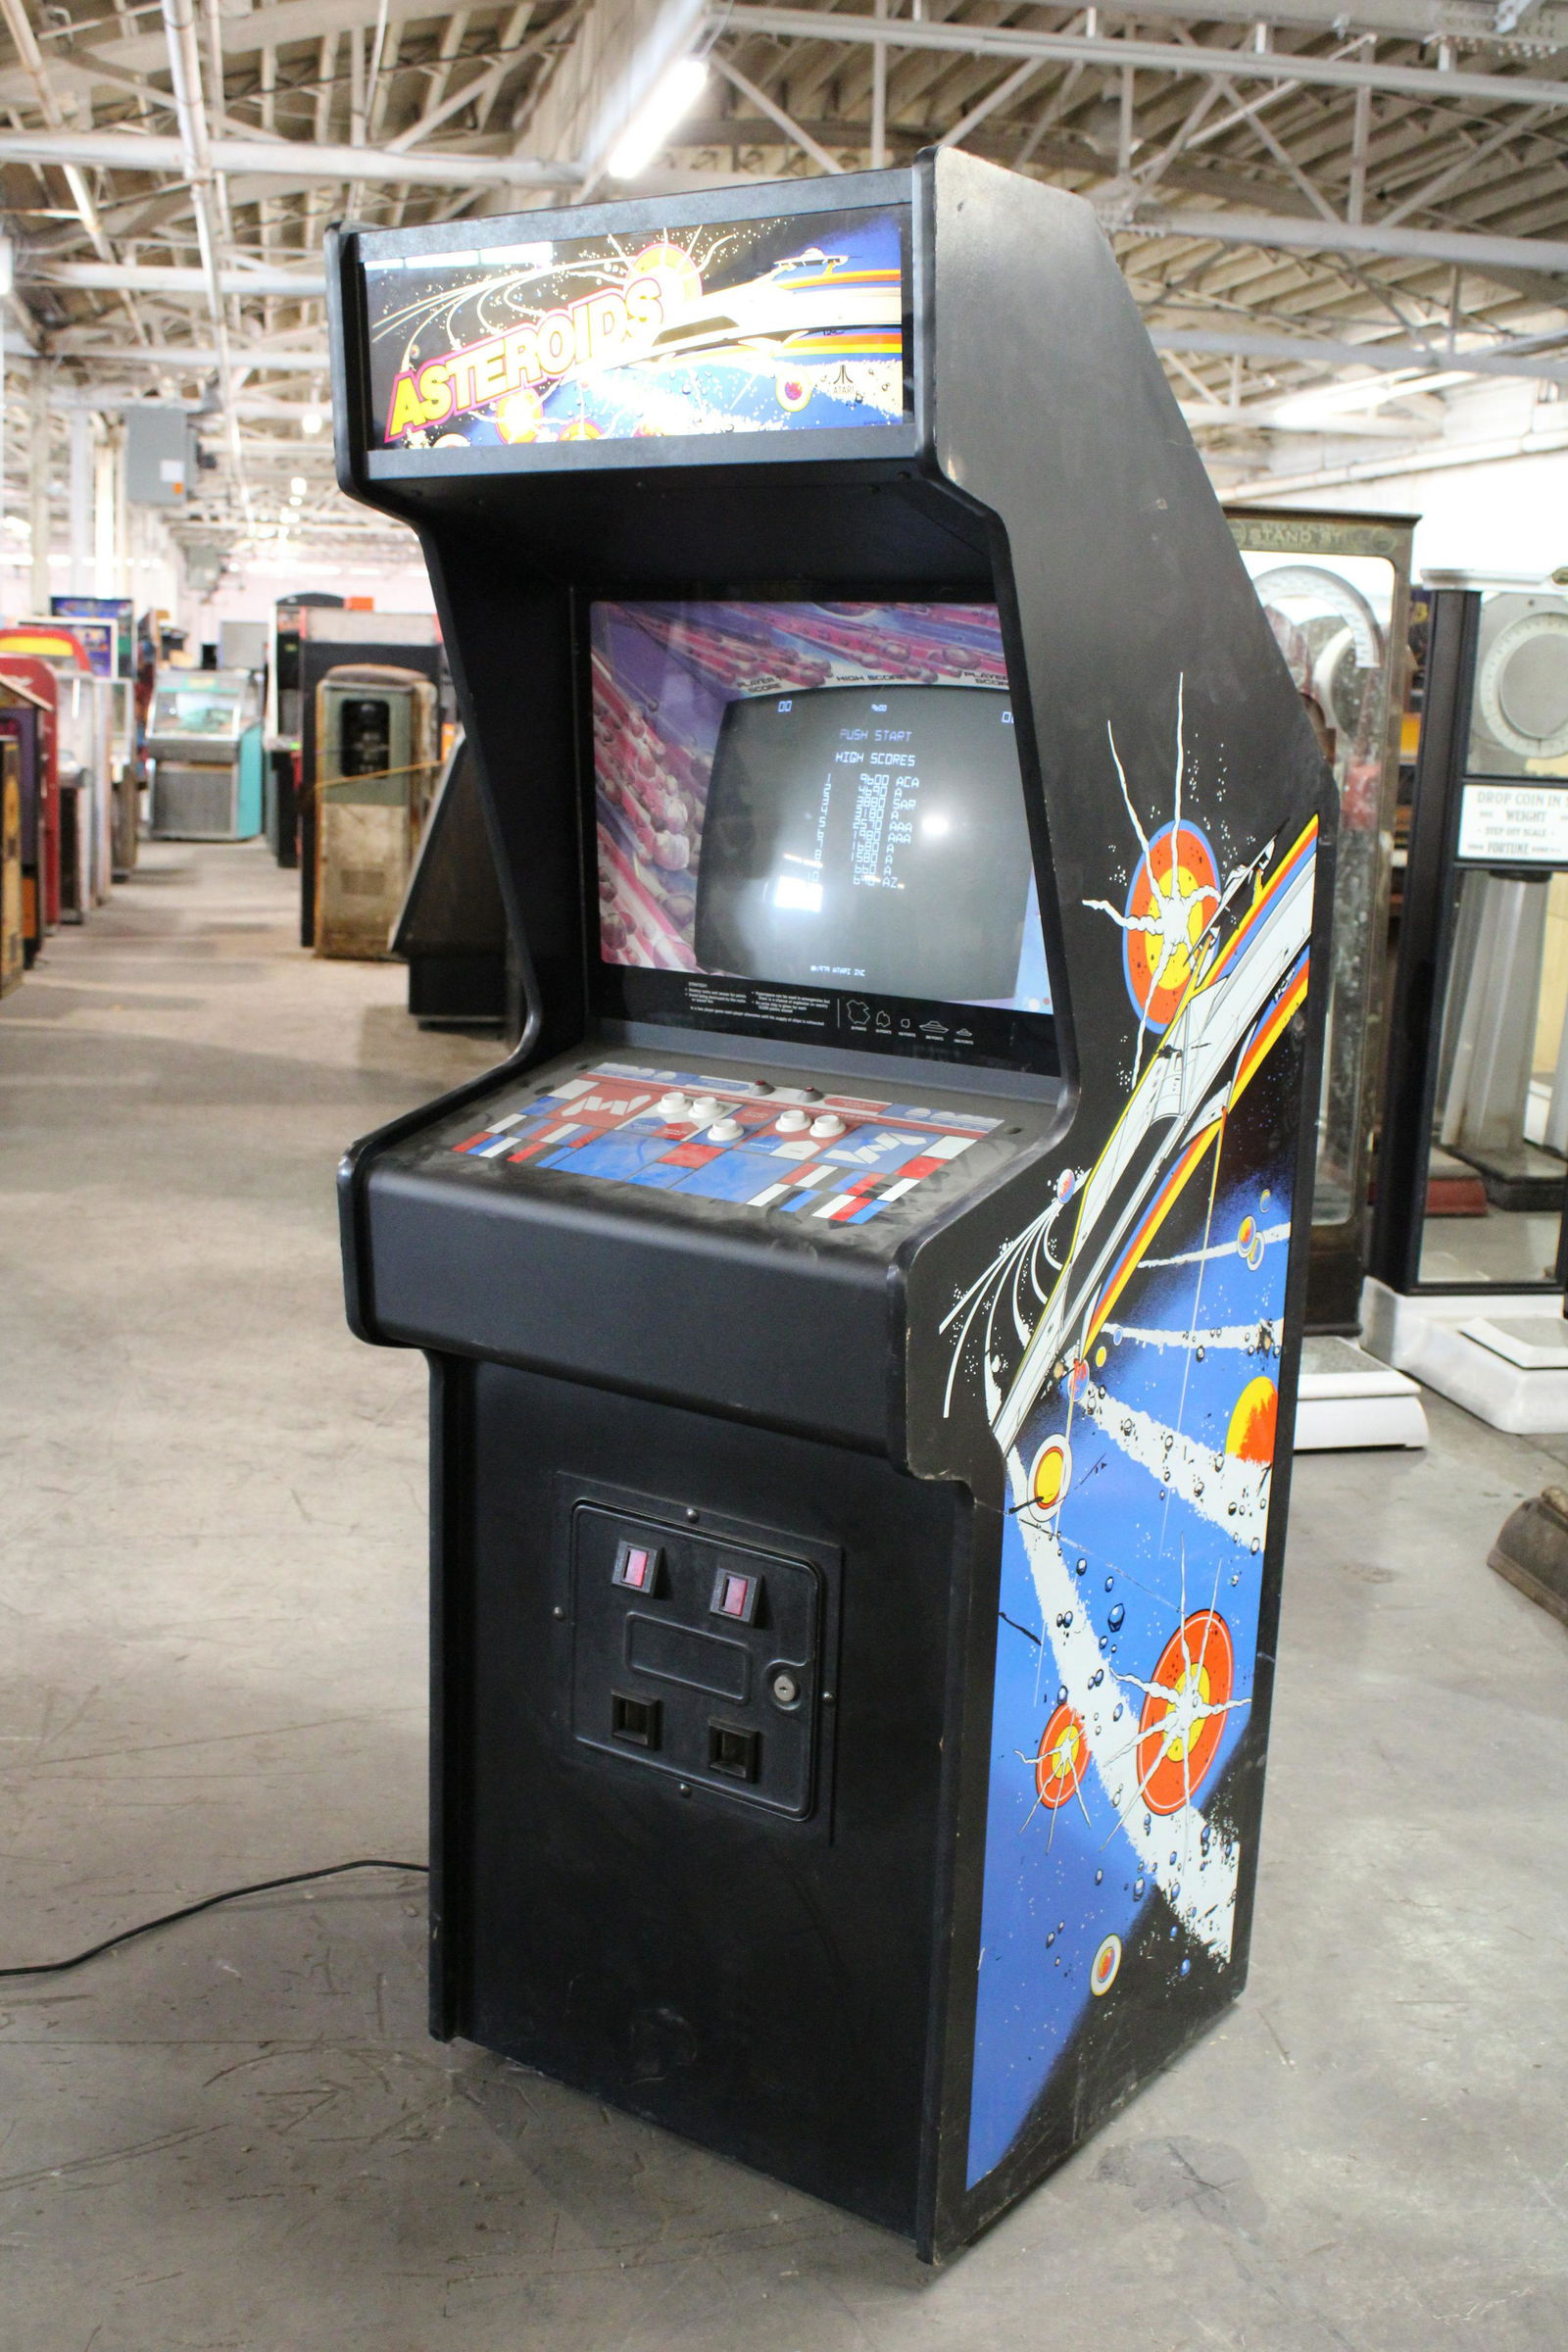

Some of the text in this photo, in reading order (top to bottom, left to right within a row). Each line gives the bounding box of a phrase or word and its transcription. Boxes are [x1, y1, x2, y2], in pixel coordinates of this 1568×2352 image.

[386, 276, 663, 442] ASTEROIDS
[833, 385, 855, 394] ATARI
[748, 683, 782, 693] SCORE
[840, 728, 912, 742] PUSH START
[835, 752, 916, 766] HIGH SCORES
[860, 773, 890, 786] 9600
[896, 776, 920, 788] ACA
[895, 788, 903, 798] A
[893, 799, 916, 810] SAR
[1477, 791, 1511, 805] DROP
[1515, 792, 1544, 806] COIN
[1547, 795, 1562, 807] IN
[890, 810, 900, 820] A
[1506, 810, 1546, 823] WEIGHT
[889, 821, 913, 833] AAA
[887, 833, 911, 844] AAA
[886, 843, 895, 854] A
[1488, 842, 1529, 856] FORTUNE
[885, 854, 894, 864] A
